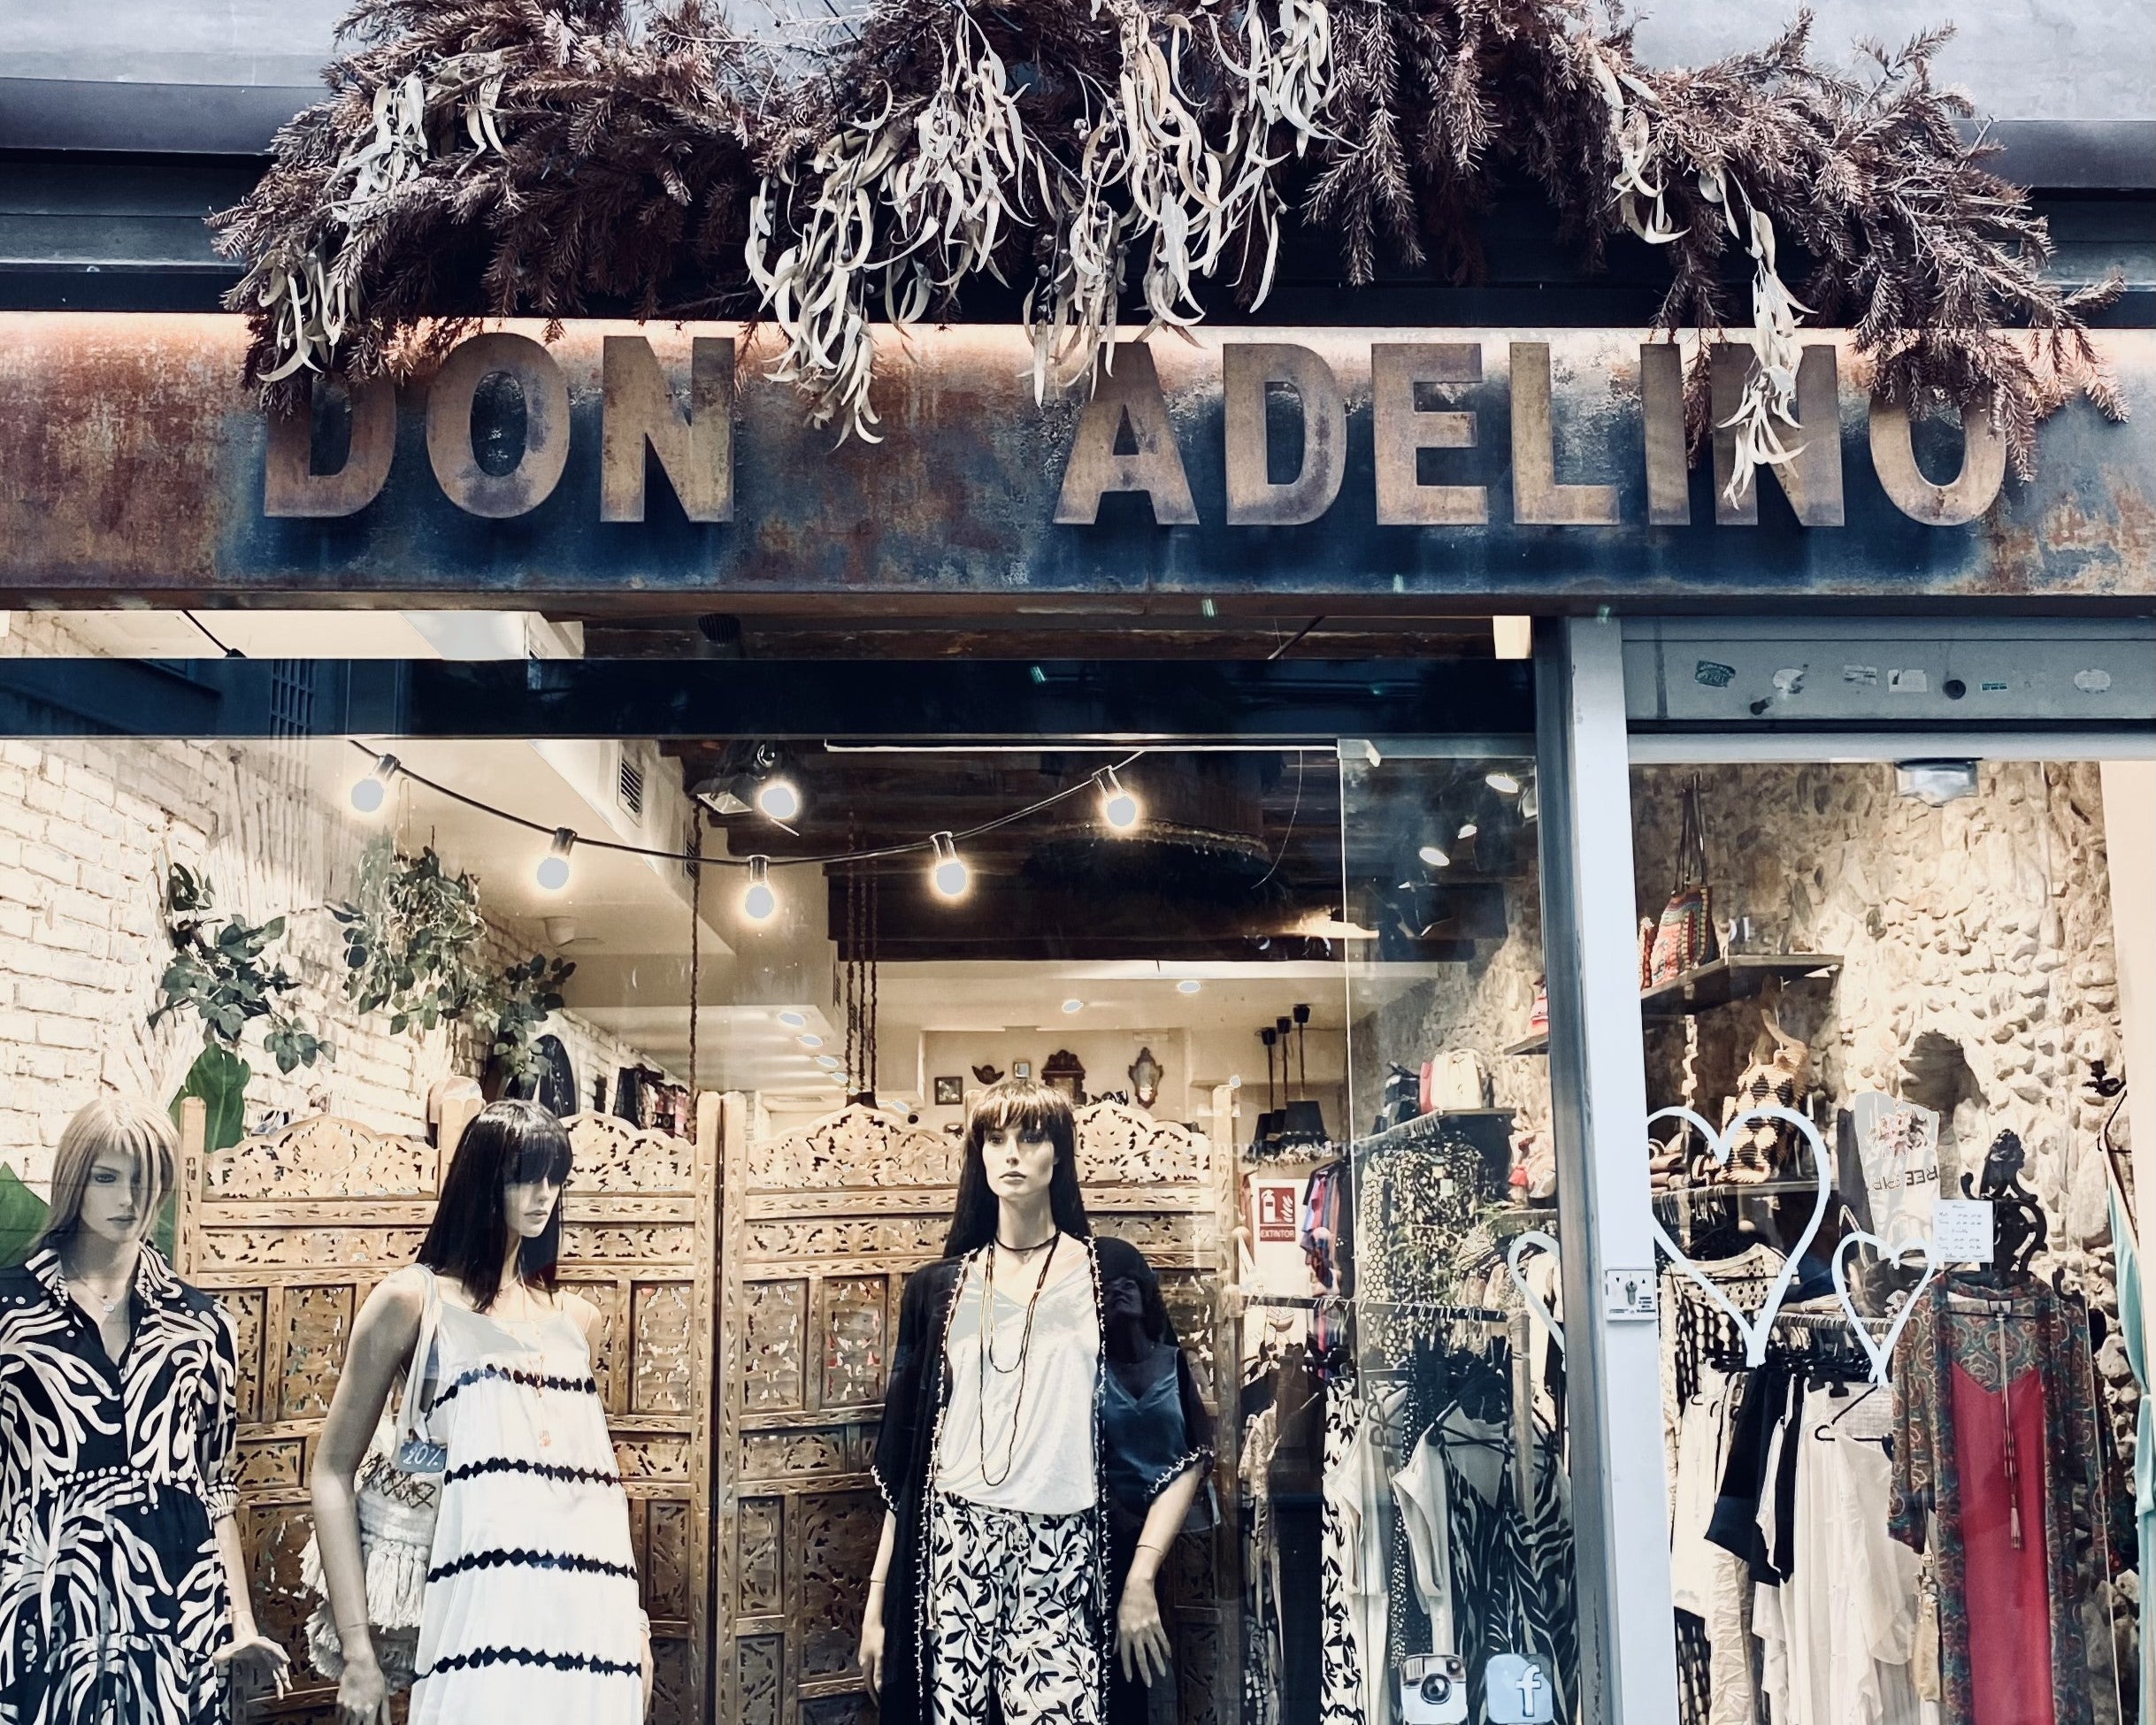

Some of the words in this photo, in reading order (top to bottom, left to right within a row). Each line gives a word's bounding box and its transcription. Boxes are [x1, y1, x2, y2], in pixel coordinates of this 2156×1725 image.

[264, 332, 735, 523] DON
[1052, 341, 2007, 527] ADELINO
[1905, 1165, 1938, 1186] REE
[1260, 1230, 1295, 1238] EXTINTOR
